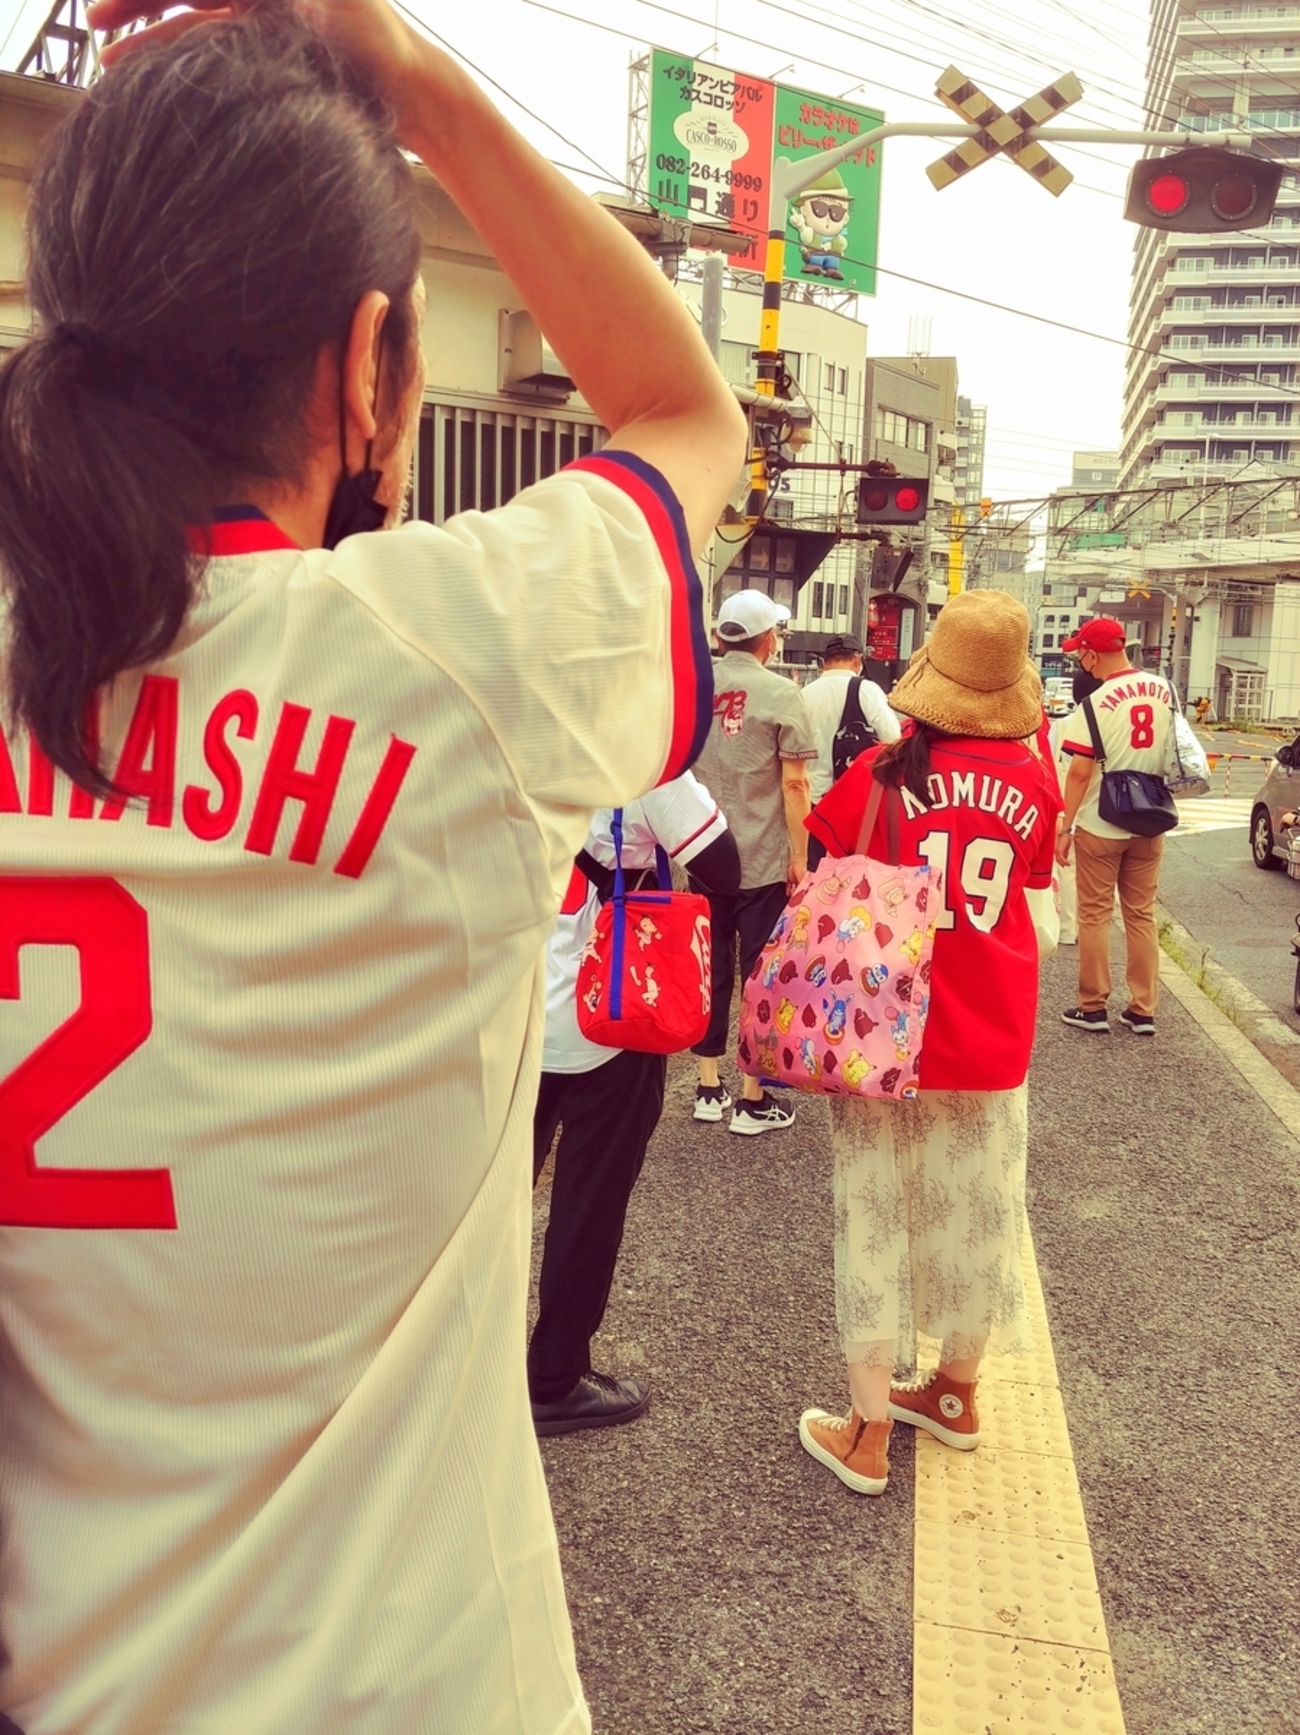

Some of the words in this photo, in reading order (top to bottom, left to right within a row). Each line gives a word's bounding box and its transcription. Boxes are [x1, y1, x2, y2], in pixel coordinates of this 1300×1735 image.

[655, 153, 763, 192] 082-264-9999
[1099, 681, 1172, 712] YAMAMOTO
[1130, 703, 1154, 750] 8
[917, 829, 1016, 935] 19
